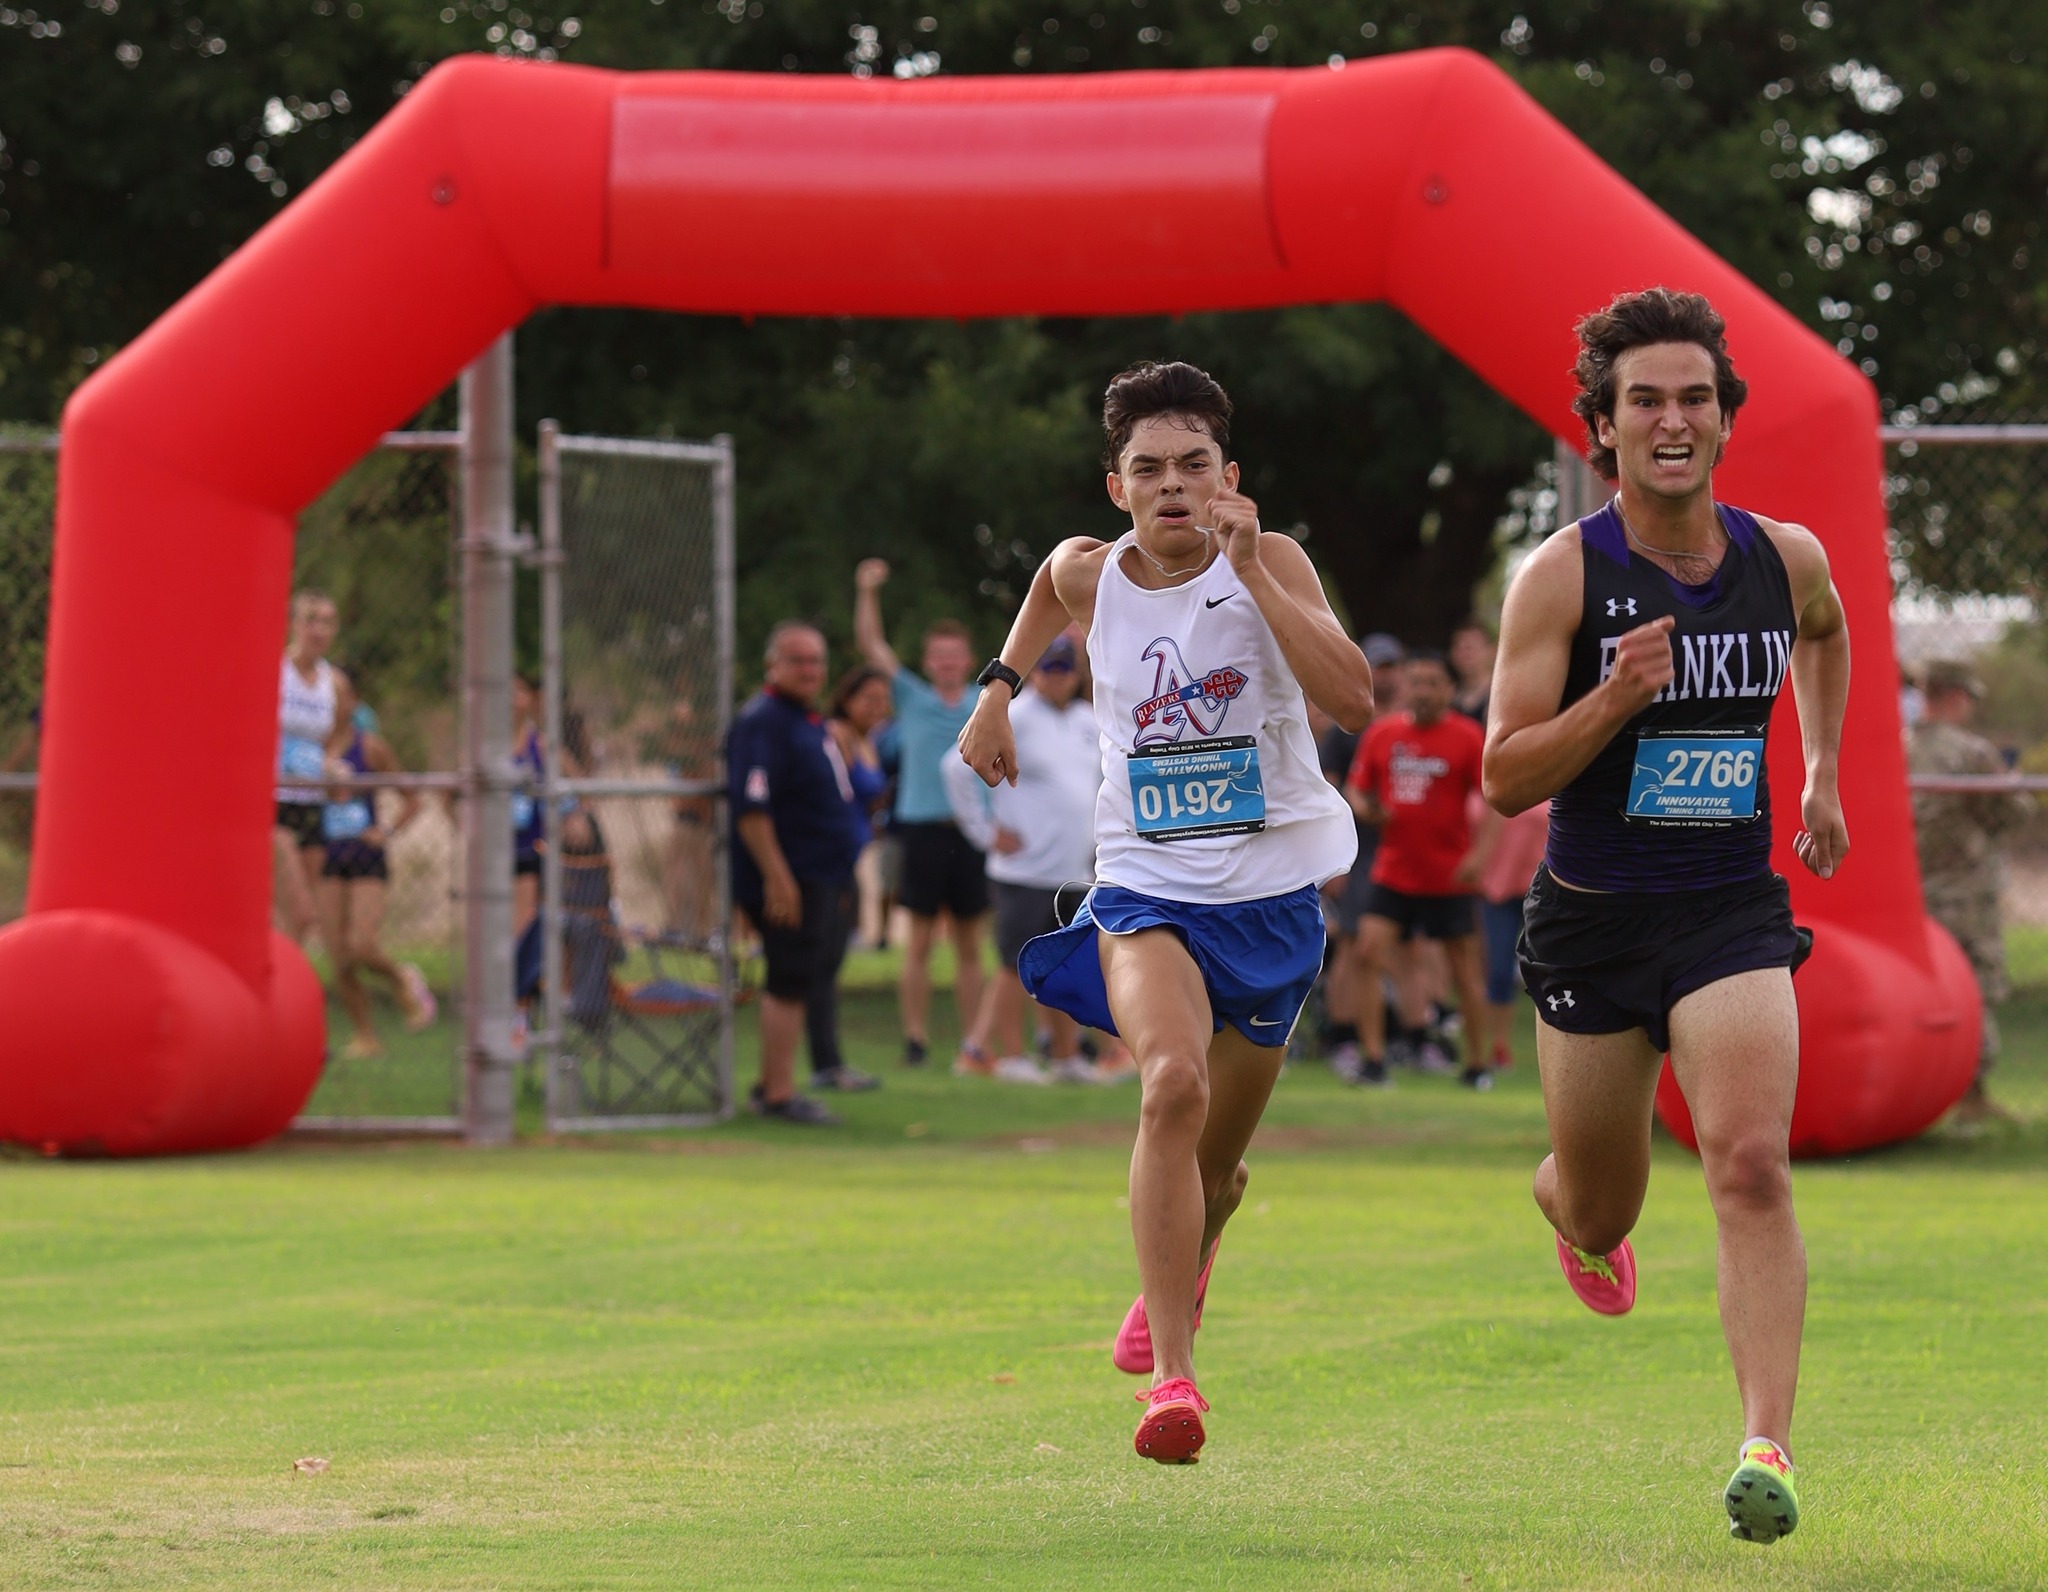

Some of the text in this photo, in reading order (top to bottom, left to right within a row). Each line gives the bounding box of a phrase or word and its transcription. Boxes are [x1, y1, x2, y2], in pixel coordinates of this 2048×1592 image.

[1599, 630, 1790, 703] FNKLIN
[1136, 692, 1181, 722] BLAZERS
[1152, 753, 1221, 767] TIMING SYSTEMS
[1157, 761, 1231, 777] INNOVATIVE
[1663, 749, 1756, 788] 2766
[1138, 778, 1232, 821] 2610
[1656, 796, 1731, 807] INNOVATIVE
[1664, 807, 1693, 815] TIMING
